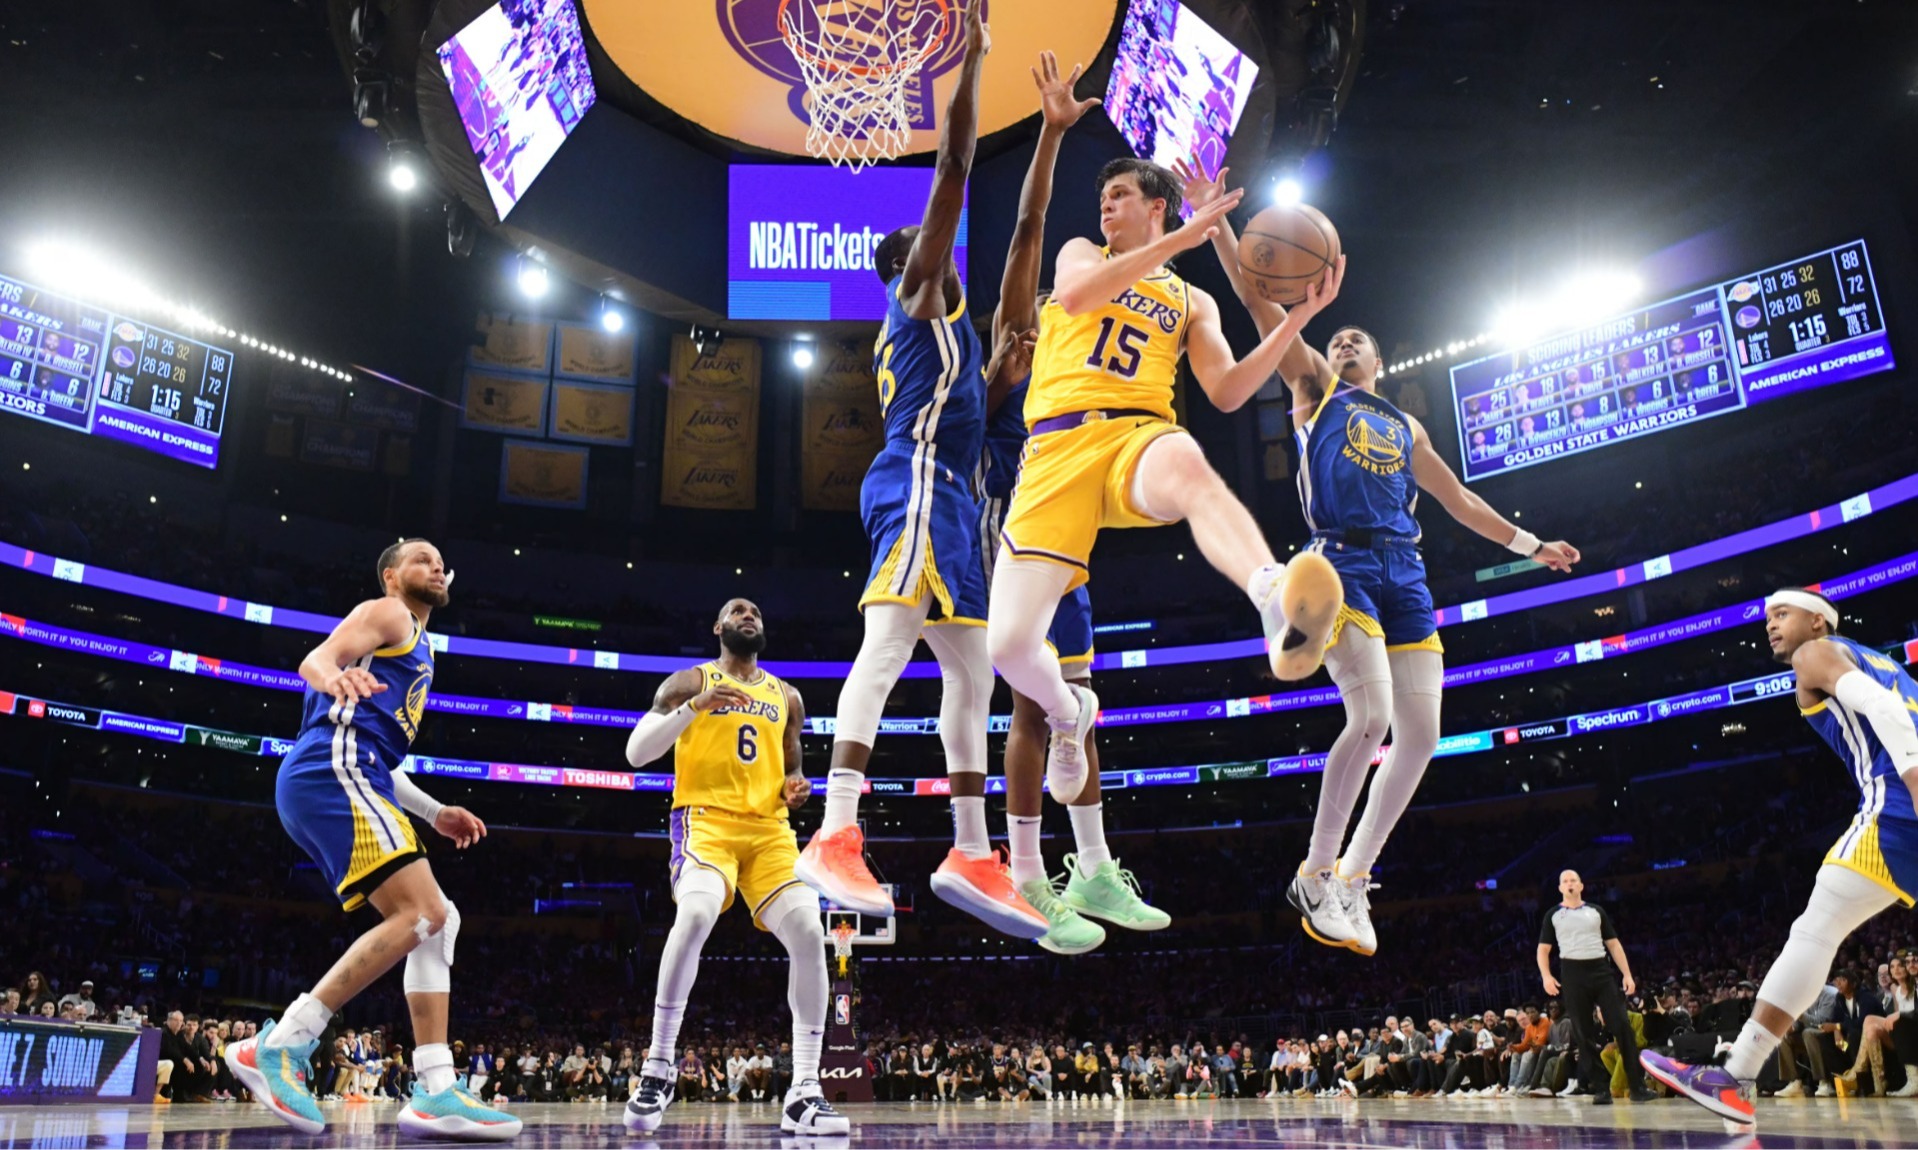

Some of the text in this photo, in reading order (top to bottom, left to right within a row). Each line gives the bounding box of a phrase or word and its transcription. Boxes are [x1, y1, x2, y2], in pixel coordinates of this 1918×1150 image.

[1763, 250, 1860, 294] 31 25 32 88
[1769, 274, 1865, 318] 26 20 26 72
[1111, 288, 1182, 334] KERS
[16, 325, 34, 344] 13
[1608, 323, 1681, 353] LAKERS
[1788, 313, 1827, 343] 1:15
[1083, 316, 1150, 382] 15
[1528, 316, 1636, 365] SCORING LEADERS
[1697, 330, 1714, 349] 12
[72, 343, 89, 362] 12
[147, 334, 225, 373] 31 25 32 88
[1643, 345, 1659, 365] 13
[10, 361, 23, 379] 6
[142, 357, 221, 395] 26 20 26 72
[1591, 361, 1606, 380] 15
[1707, 364, 1719, 384] 6
[1748, 346, 1885, 392] AMERICAN EXPRESS
[67, 379, 80, 396] 6
[1540, 376, 1555, 396] 18
[1652, 380, 1662, 399] 6
[151, 384, 182, 411] 1:15
[1490, 390, 1507, 411] 25
[1599, 396, 1609, 414] 8
[687, 410, 739, 431] LAKERS
[1545, 409, 1560, 430] 13
[98, 414, 214, 455] AMERICAN EXPRESS
[1386, 426, 1396, 440] 3
[1495, 423, 1512, 444] 26
[1504, 404, 1697, 467] GOLDEN STATE WARRIORS
[1342, 444, 1405, 476] WARRIORS
[1849, 580, 1857, 590] IT
[1858, 577, 1867, 587] IF
[1867, 571, 1886, 584] YOU
[1887, 560, 1917, 577] ENJOY
[19, 626, 49, 639] WORTH
[49, 633, 58, 642] IT
[59, 634, 68, 643] IF
[69, 637, 88, 648] YOU
[89, 641, 119, 654] ENJOY
[119, 646, 129, 655] IT
[1620, 636, 1649, 648] WORTH
[1650, 633, 1657, 642] IT
[1658, 630, 1666, 639] IF
[1666, 627, 1684, 638] YOU
[1685, 619, 1712, 633] ENJOY
[1713, 616, 1722, 626] IT
[214, 666, 242, 677] WORTH
[260, 674, 277, 684] YOU
[278, 677, 305, 688] ENJOY
[1466, 671, 1473, 679] IT
[1482, 667, 1499, 677] YOU
[1499, 661, 1525, 672] ENJOY
[1526, 659, 1534, 668] IT
[1754, 676, 1792, 696] 9:06
[439, 700, 454, 708] YOU
[456, 701, 480, 711] ENJOY
[1308, 694, 1324, 702] YOU
[1671, 693, 1722, 712] crypto.com
[47, 706, 86, 721] TOYOTA
[610, 715, 625, 723] YOU
[1140, 711, 1156, 719] YOU
[1156, 710, 1180, 718] ENJOY
[1577, 708, 1638, 731] Spectrum
[106, 717, 180, 736] AMERICAN EXPRESS
[881, 721, 918, 731] Warriors
[1520, 725, 1555, 738] TOYOTA
[738, 724, 757, 763] 6
[1435, 736, 1481, 751] obilitie
[436, 762, 482, 774] crypto.com
[1308, 757, 1328, 767] ULT
[566, 771, 631, 787] TOSHIBA
[1146, 771, 1190, 782] crypto.com
[873, 783, 904, 791] TOYOTA
[18, 1033, 35, 1087] 7
[42, 1035, 104, 1087] SUNDAY
